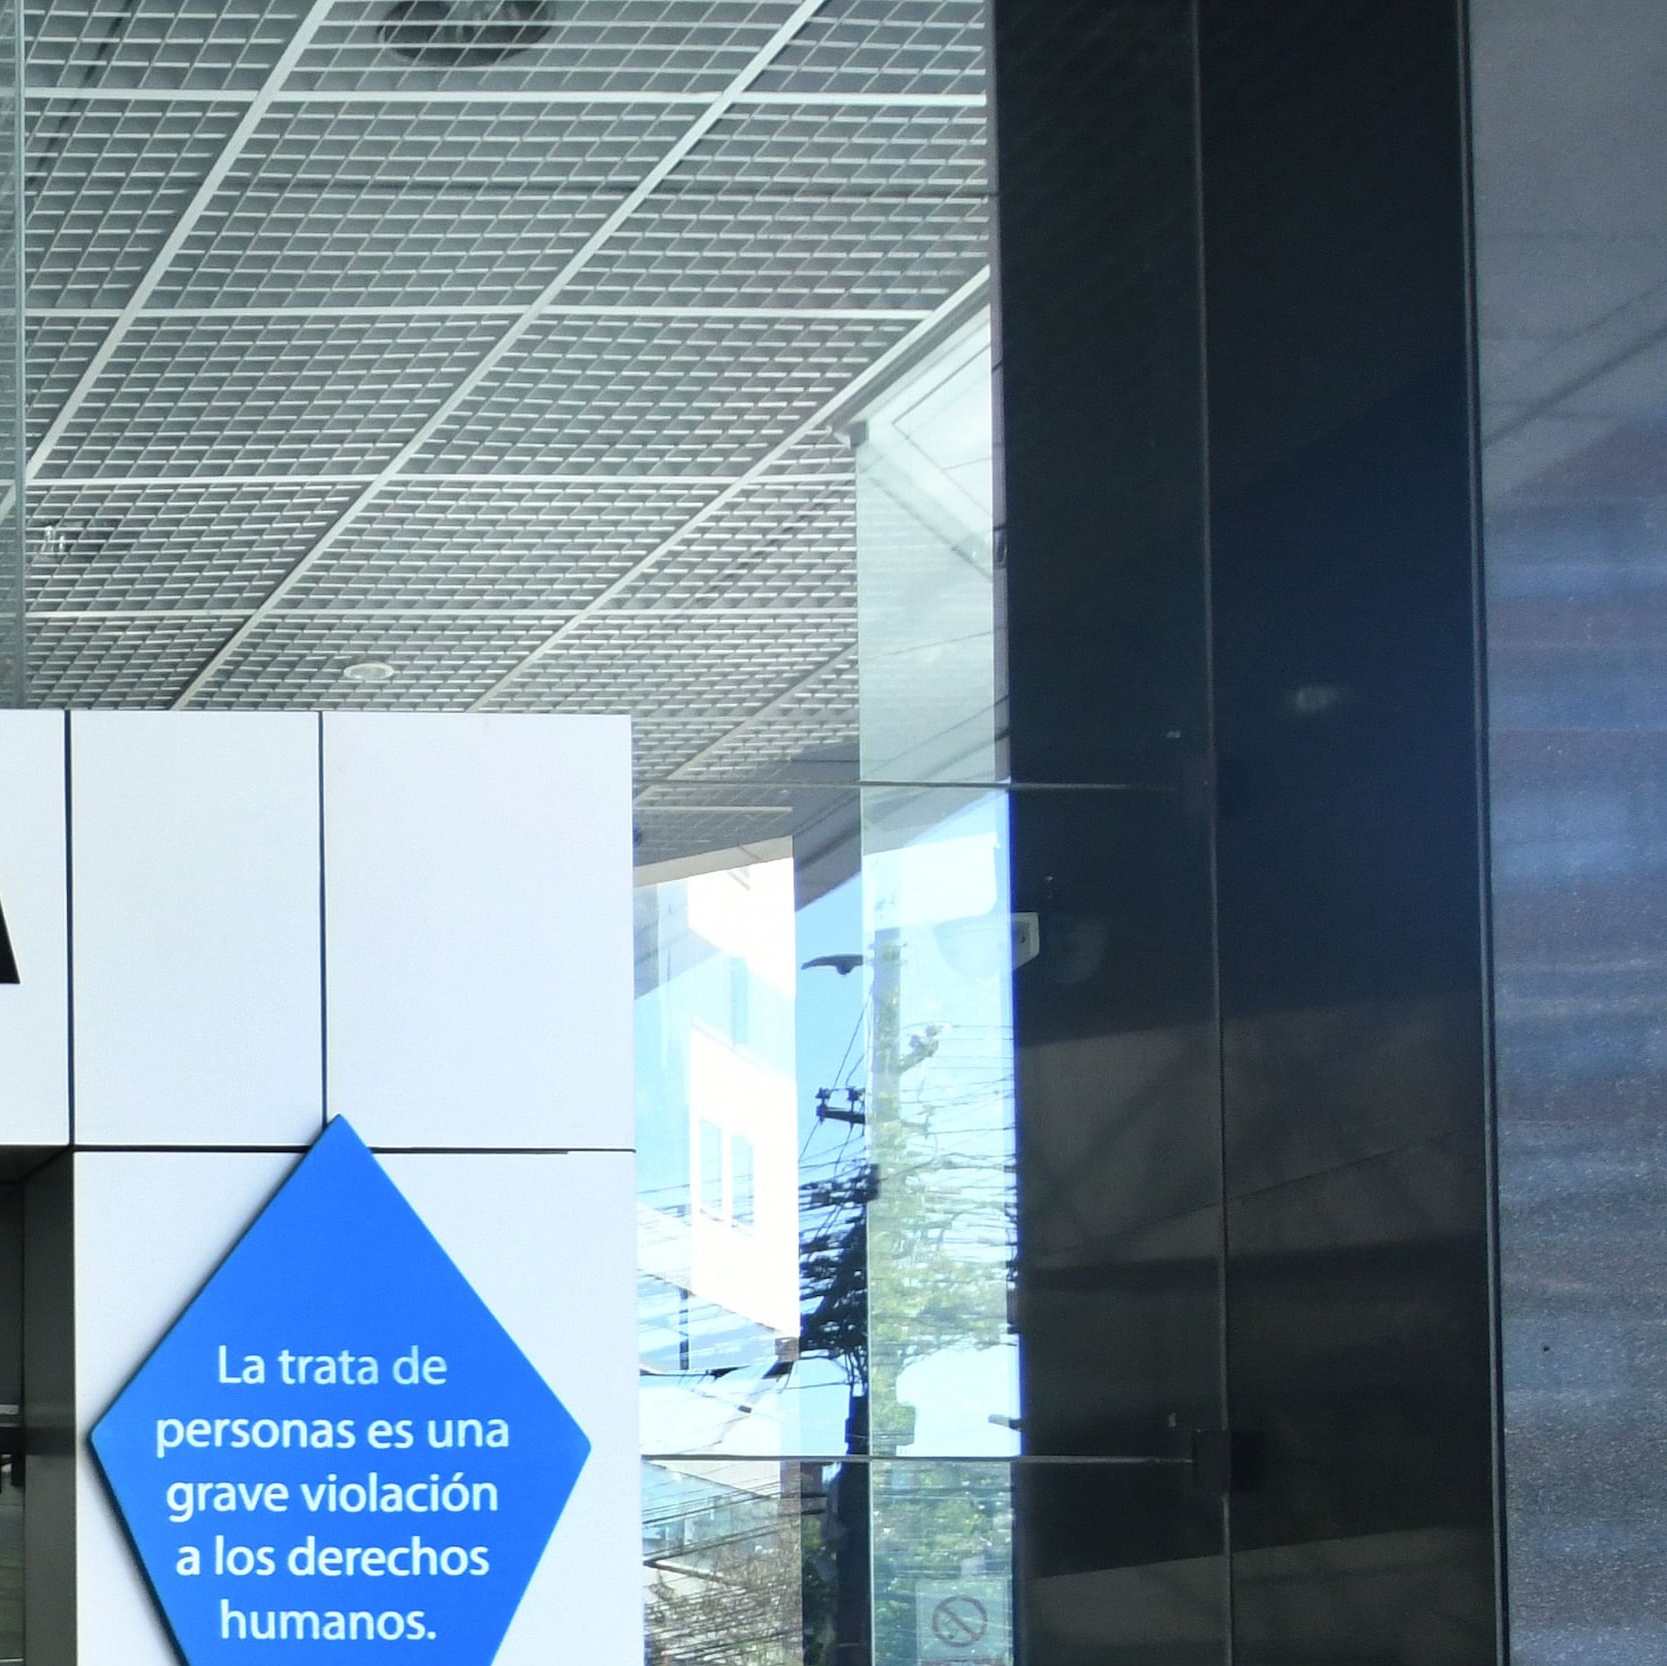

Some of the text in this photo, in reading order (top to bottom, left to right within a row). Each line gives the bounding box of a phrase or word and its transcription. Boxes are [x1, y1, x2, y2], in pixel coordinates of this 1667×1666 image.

[218, 1345, 447, 1385] La trata de
[157, 1418, 509, 1459] personas es una
[166, 1471, 498, 1523] grave violación
[175, 1534, 490, 1577] a los derechos
[220, 1598, 437, 1641] humanos.
